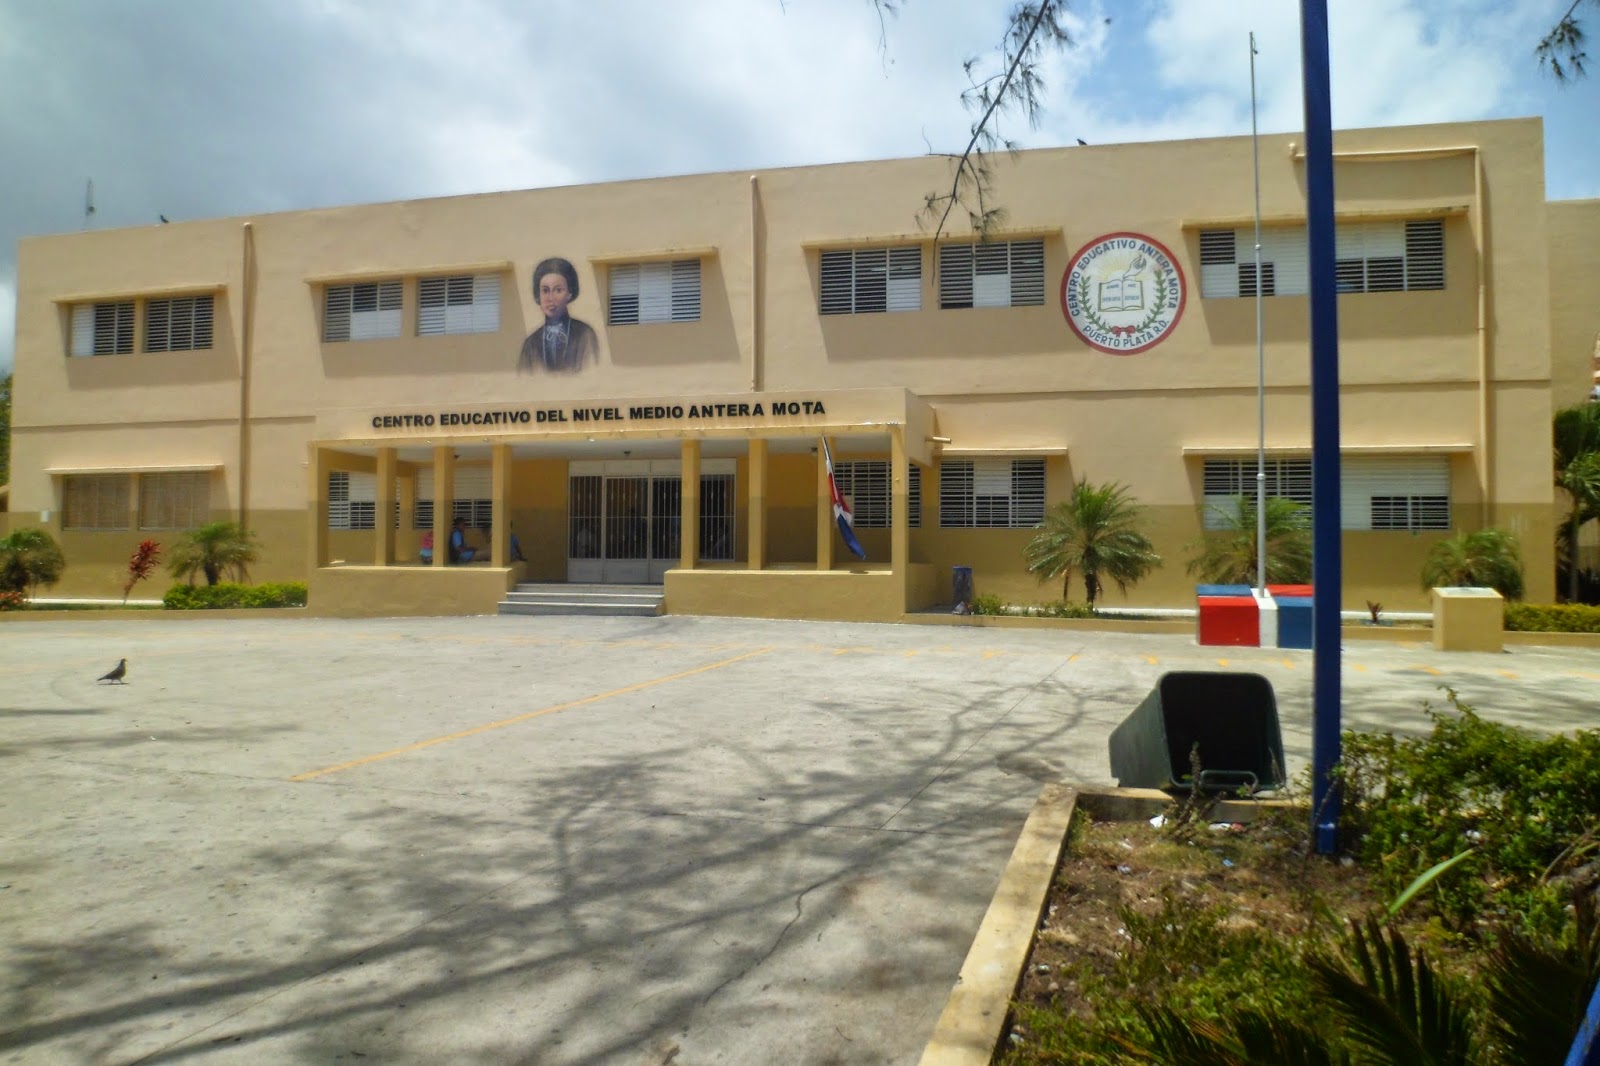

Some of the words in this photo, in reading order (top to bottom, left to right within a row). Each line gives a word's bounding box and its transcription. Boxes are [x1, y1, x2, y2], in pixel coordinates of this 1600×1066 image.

[1068, 271, 1081, 317] CENTRO
[1077, 239, 1136, 270] EDUCATIVO
[1138, 243, 1174, 276] ANTERA
[1167, 277, 1179, 309] MOTA
[1083, 325, 1120, 347] PUERTO
[1123, 331, 1154, 347] PLATA
[372, 414, 435, 428] CENTRO
[440, 411, 531, 426] EDUCATIVO
[536, 409, 568, 422] DEL
[573, 407, 624, 421] NIVEL
[629, 405, 684, 420] MEDIO
[688, 403, 765, 418] ANTERA
[772, 401, 826, 416] MOTA
